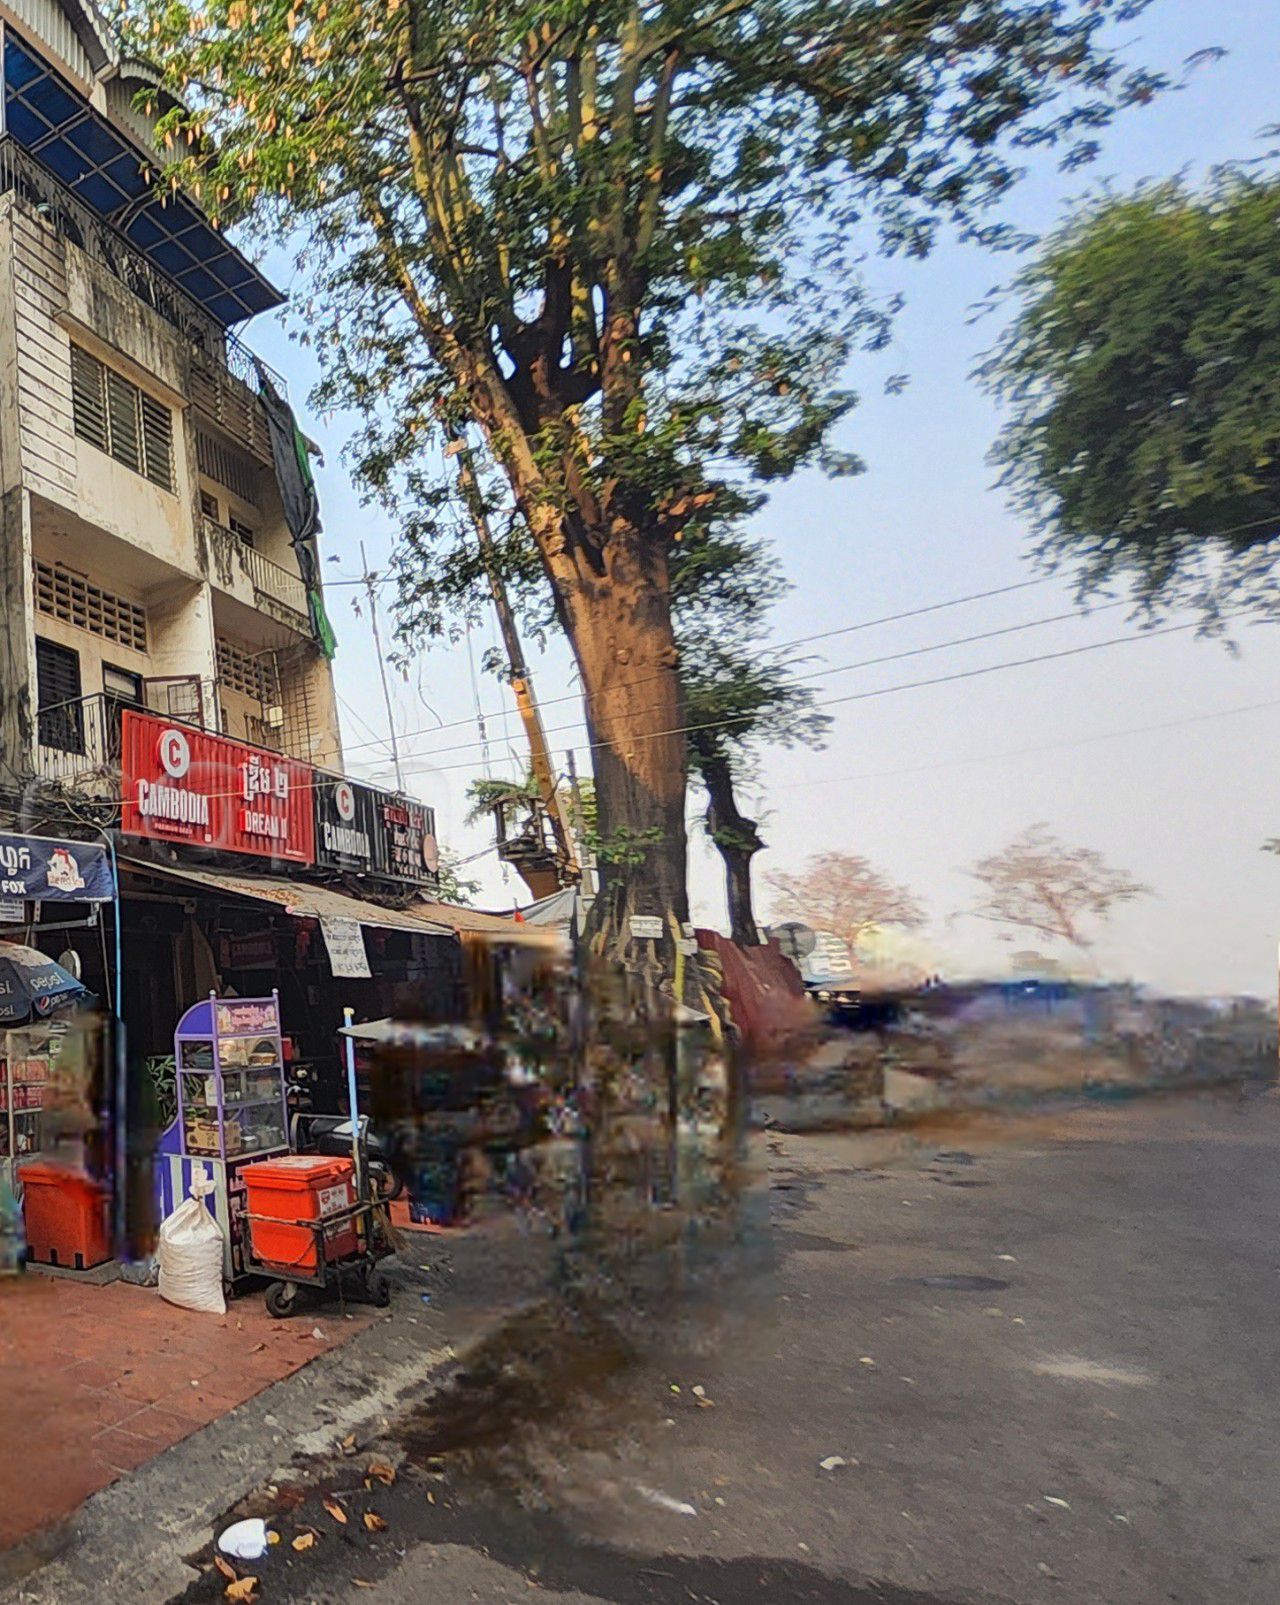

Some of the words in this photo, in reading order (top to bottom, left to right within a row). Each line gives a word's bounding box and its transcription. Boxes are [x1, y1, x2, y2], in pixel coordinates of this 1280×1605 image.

[135, 779, 209, 825] CAMBODIA
[244, 809, 279, 837] DREAM
[323, 821, 370, 858] CAMBODIA
[2, 880, 27, 895] FOX
[30, 971, 65, 991] pepsi
